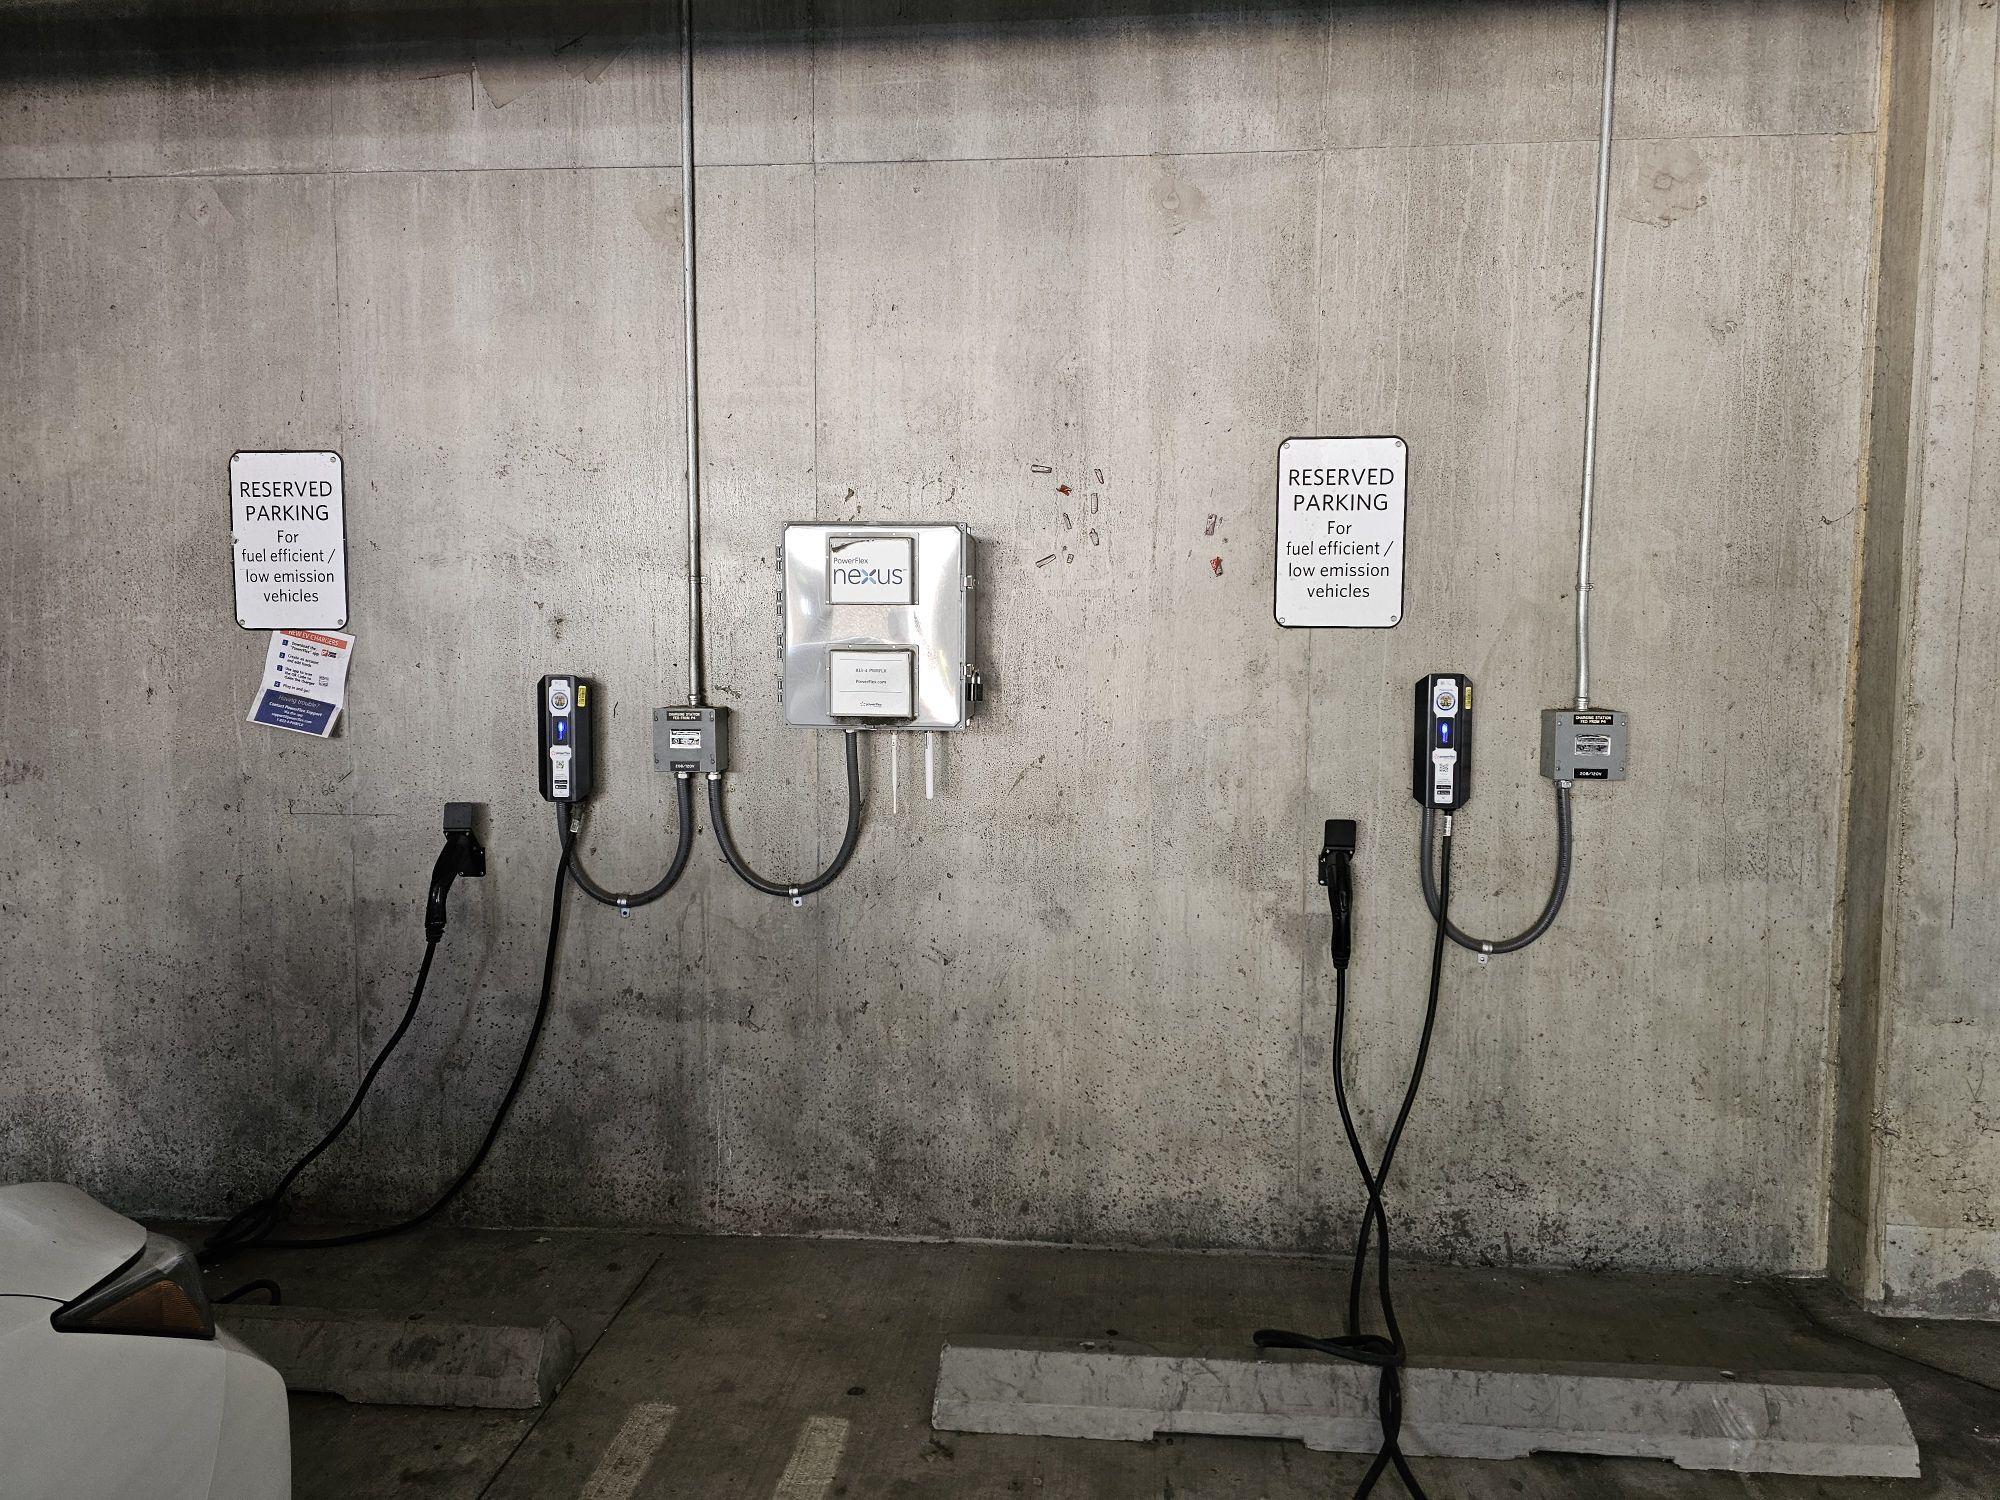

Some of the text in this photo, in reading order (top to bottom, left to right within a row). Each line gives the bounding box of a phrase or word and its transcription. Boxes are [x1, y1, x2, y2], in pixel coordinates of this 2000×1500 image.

[1289, 468, 1394, 486] RESERVED
[240, 481, 332, 498] RESERVED
[1293, 494, 1388, 511] PARKING
[246, 505, 329, 522] PARKING
[1327, 520, 1352, 535] For
[277, 530, 299, 544] For
[1286, 540, 1394, 557] fuel efficient /
[242, 549, 336, 564] fuel efficient /
[246, 569, 335, 583] low emission
[833, 568, 903, 585] nexus
[1288, 562, 1389, 577] low emission
[263, 589, 319, 602] vehicles
[1307, 583, 1370, 598] vehicles
